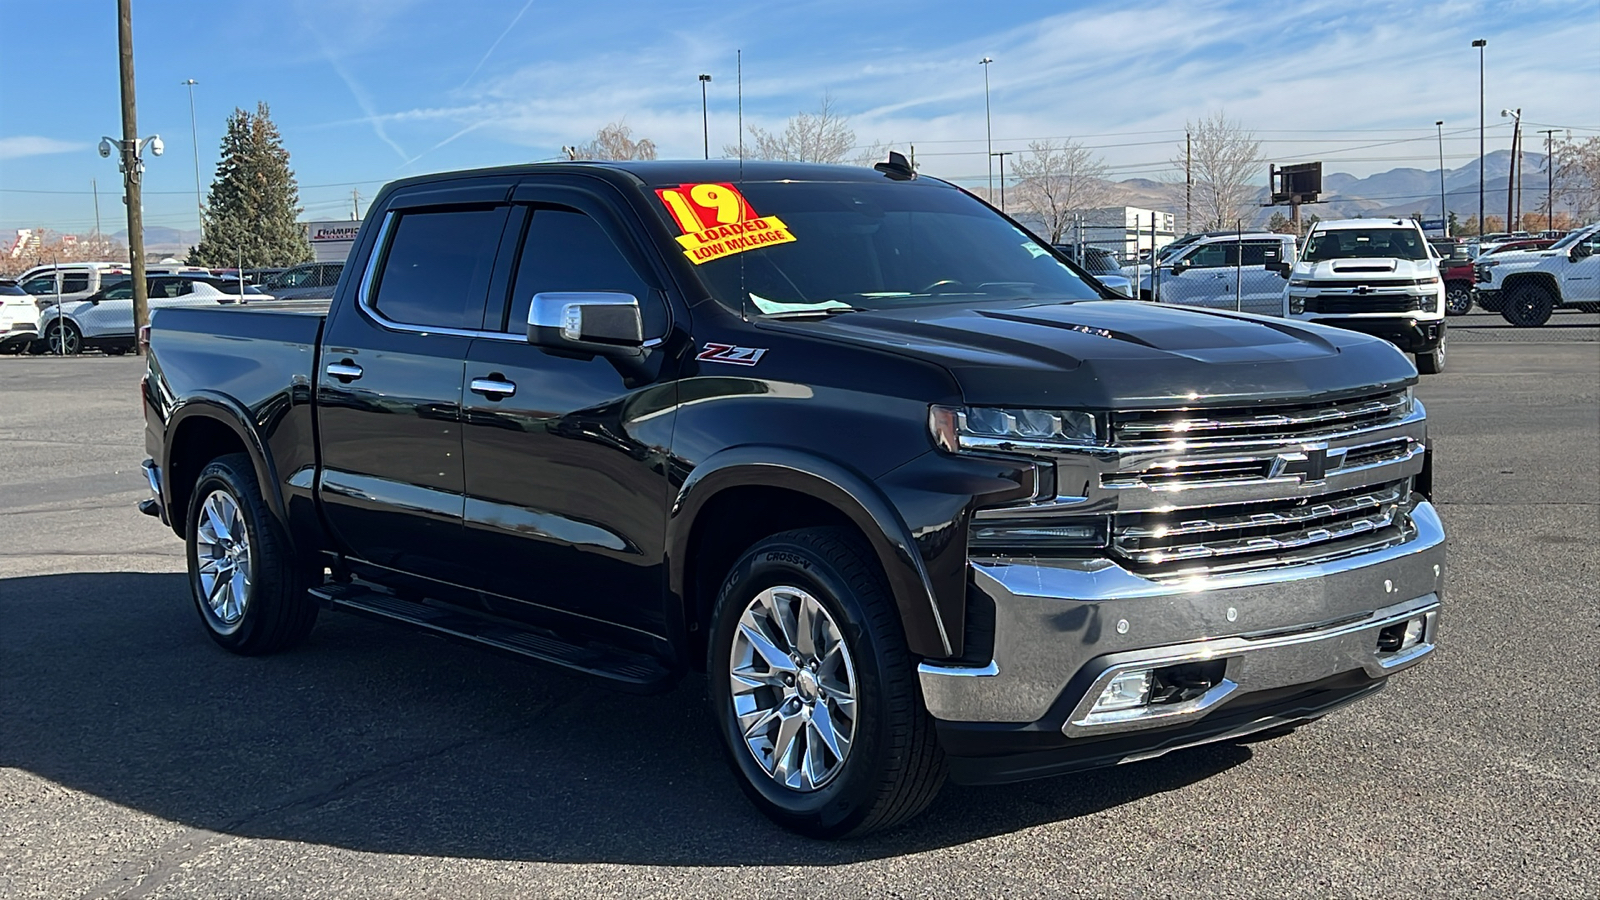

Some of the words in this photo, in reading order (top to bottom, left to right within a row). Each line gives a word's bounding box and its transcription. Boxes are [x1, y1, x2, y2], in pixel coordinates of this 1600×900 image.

[662, 184, 743, 232] 19
[693, 219, 769, 243] LOADED
[692, 243, 725, 260] LOW
[726, 230, 786, 251] MILEAGE
[694, 342, 769, 366] Z71
[766, 552, 812, 570] CROSS-V
